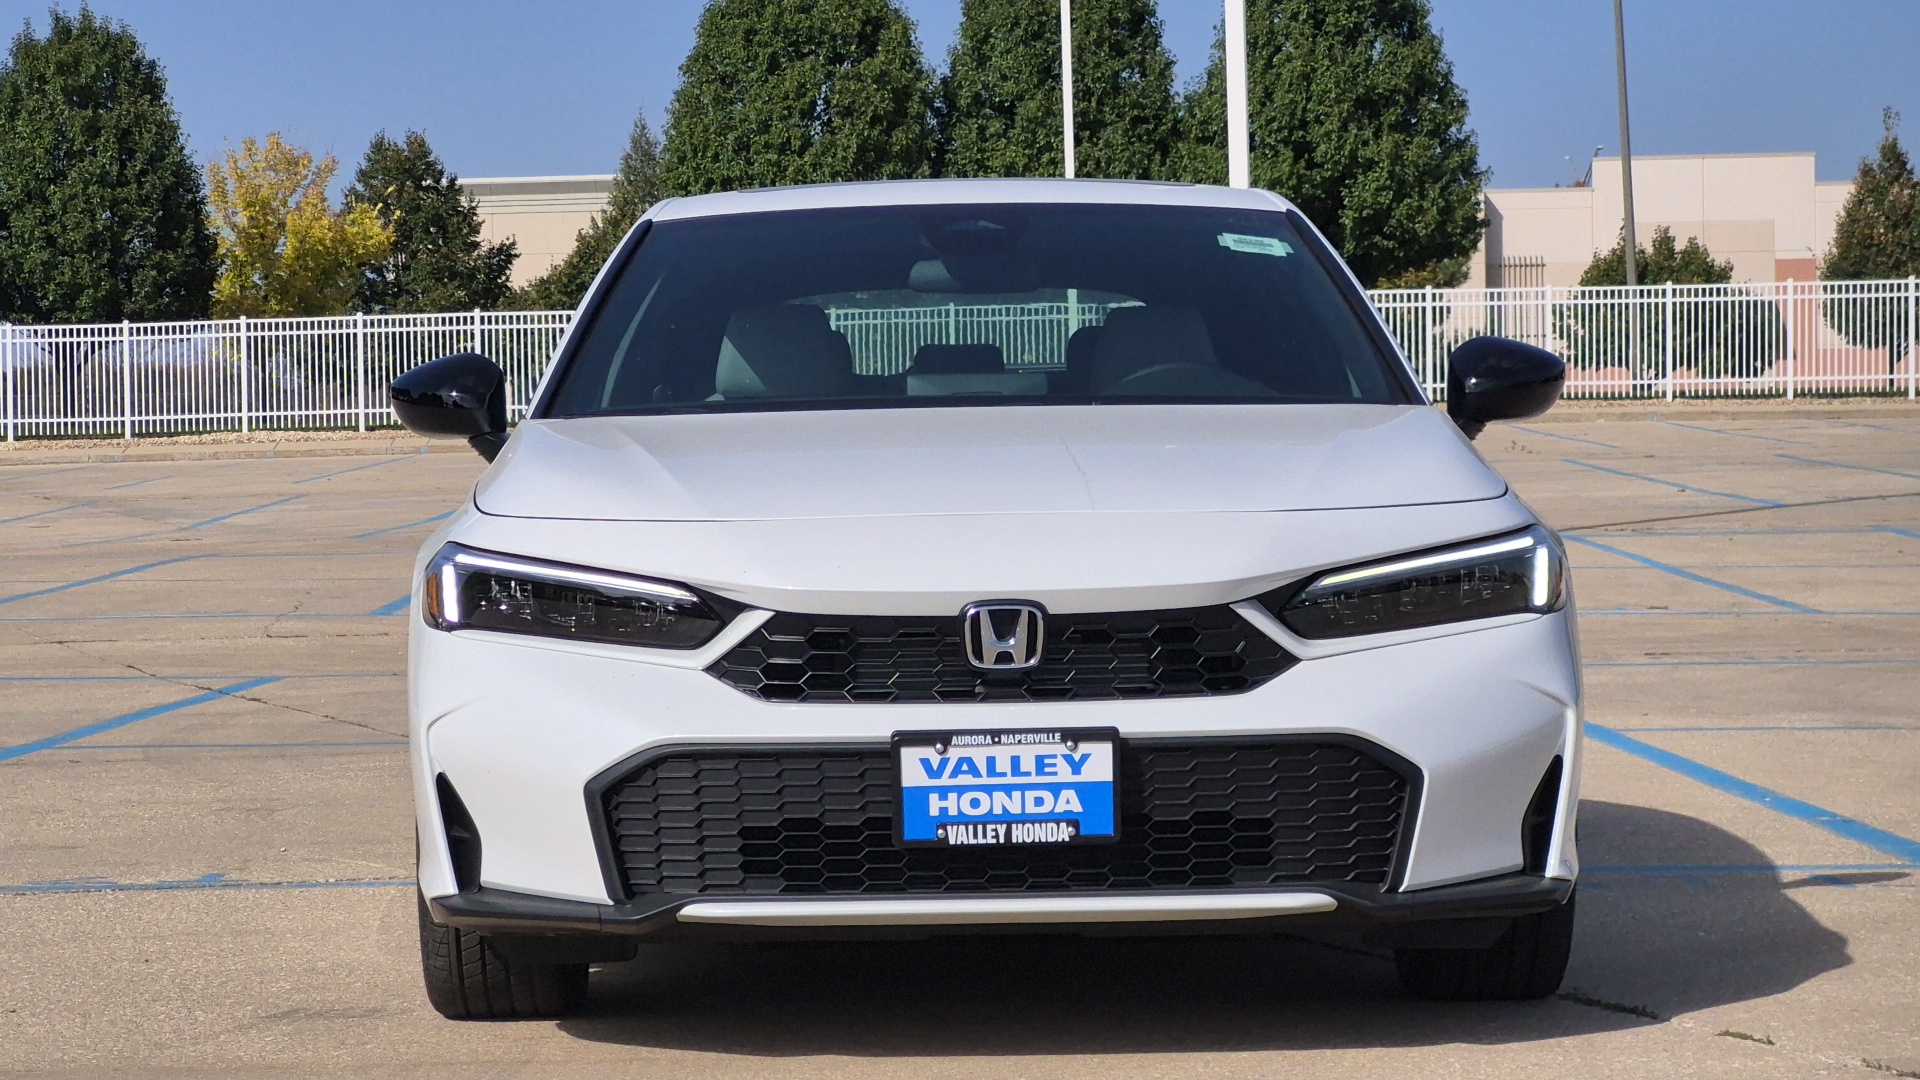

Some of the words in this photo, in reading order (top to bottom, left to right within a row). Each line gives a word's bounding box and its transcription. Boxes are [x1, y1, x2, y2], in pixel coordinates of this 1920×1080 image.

[951, 735, 993, 746] AURORA
[1000, 733, 1062, 744] NAPERVILLE
[918, 753, 1093, 780] VALLEY
[928, 789, 1084, 817] HONDA
[946, 823, 1009, 845] VALLEY
[1011, 822, 1070, 844] HONDA
